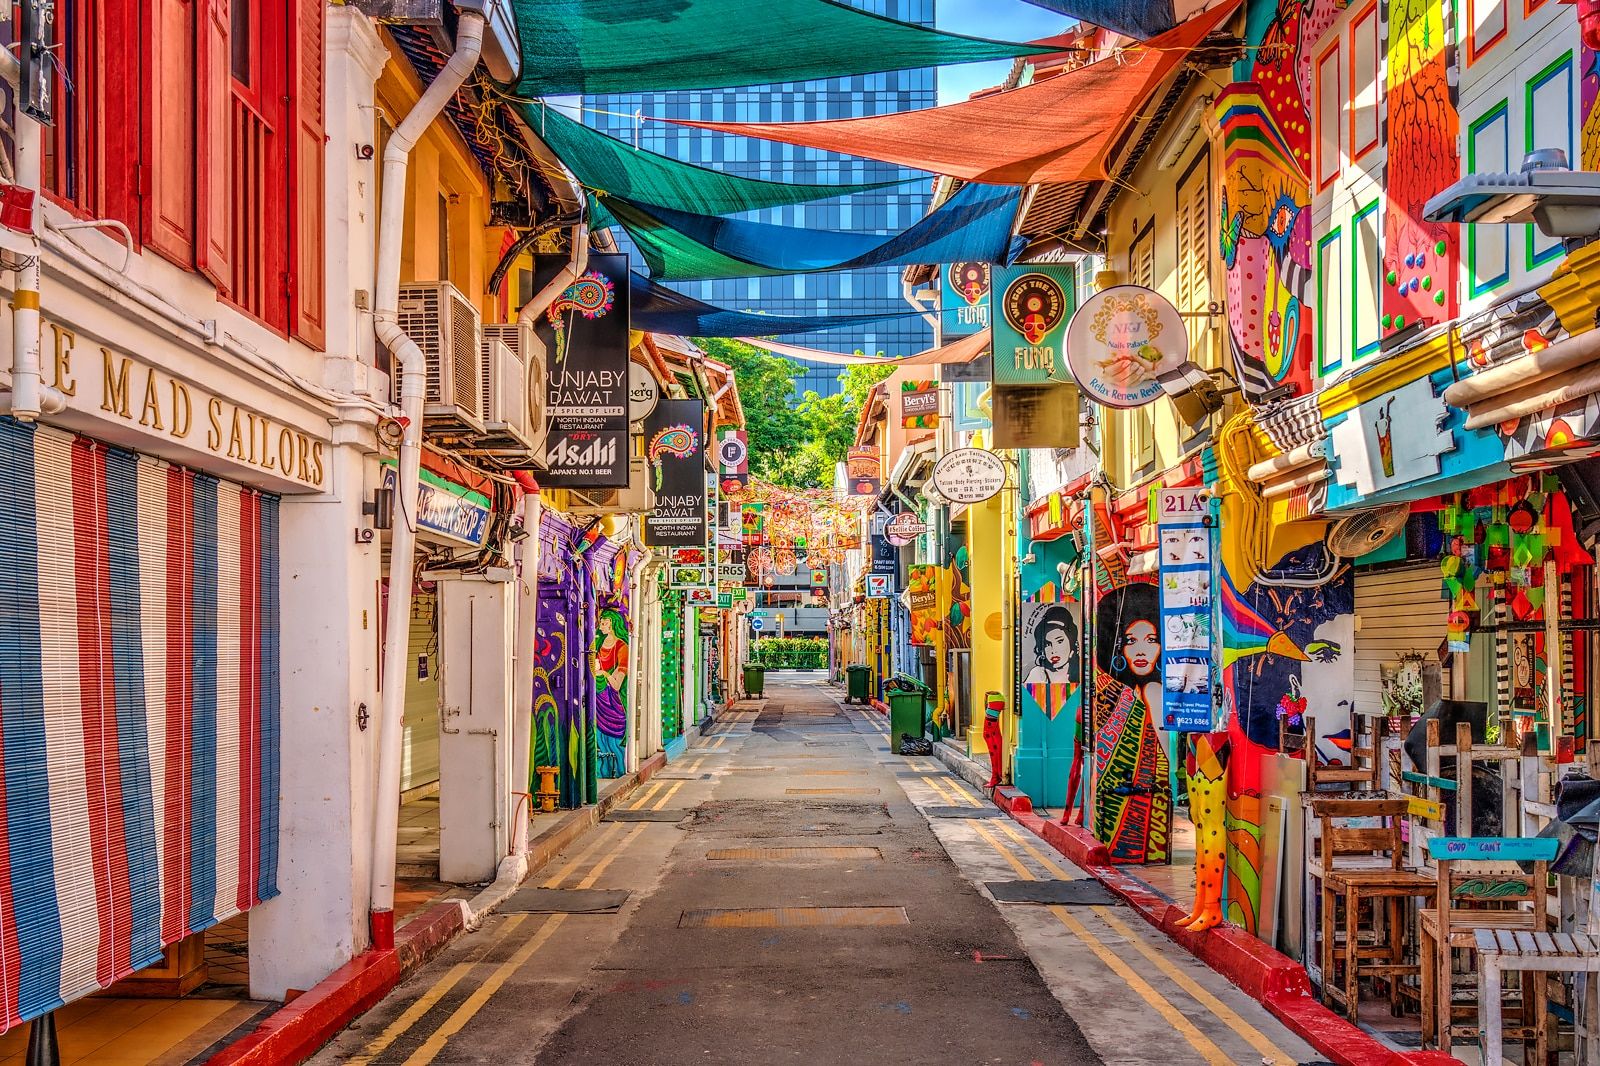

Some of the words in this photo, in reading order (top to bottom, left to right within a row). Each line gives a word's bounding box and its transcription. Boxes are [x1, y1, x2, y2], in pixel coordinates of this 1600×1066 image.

[1012, 283, 1028, 301] GOT
[1029, 281, 1049, 290] THE
[1011, 302, 1021, 318] WE
[1047, 288, 1059, 318] FUNK
[1108, 341, 1125, 349] Nails
[1127, 339, 1148, 349] Palace
[1089, 378, 1109, 396] Relax
[1111, 389, 1138, 400] Renew
[550, 390, 613, 405] DAWAT
[904, 393, 935, 407] Beryl's
[100, 347, 192, 439] MAD
[207, 397, 324, 486] SAILORS
[547, 437, 616, 466] Asahi
[727, 446, 736, 458] F
[654, 495, 702, 508] UNJABY
[1165, 493, 1204, 512] 21A
[655, 508, 694, 517] DAWAT
[452, 505, 479, 538] SHOP
[912, 593, 934, 603] Beryl's
[1447, 841, 1467, 852] GOOD
[1479, 841, 1501, 852] CAN'T
